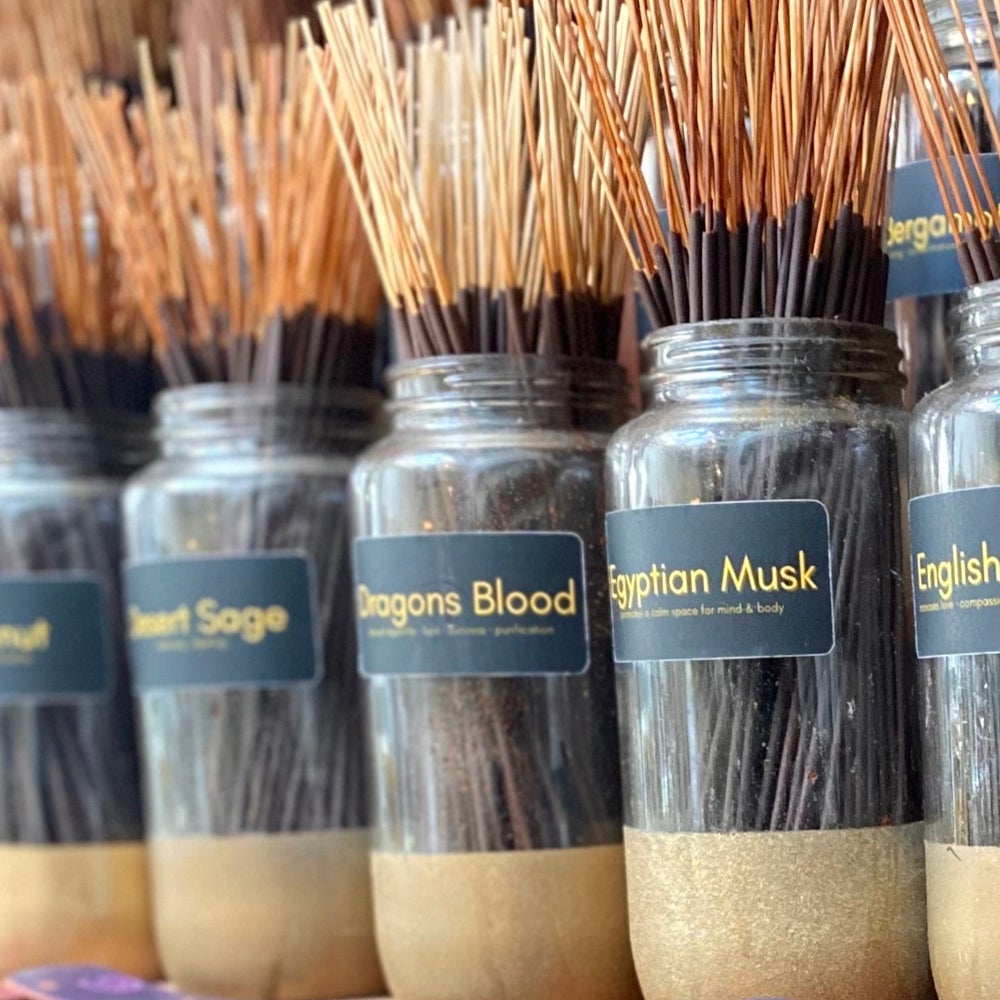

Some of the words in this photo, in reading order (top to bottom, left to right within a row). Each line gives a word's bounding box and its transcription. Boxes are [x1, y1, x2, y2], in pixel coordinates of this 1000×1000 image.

[357, 584, 462, 628] Dragons
[472, 577, 577, 616] Blood
[609, 563, 710, 610] Egyptian
[721, 550, 818, 593] Musk
[195, 597, 290, 644] Sage
[672, 607, 699, 619] space
[701, 603, 714, 616] for
[717, 602, 742, 615] mind
[757, 601, 784, 616] body
